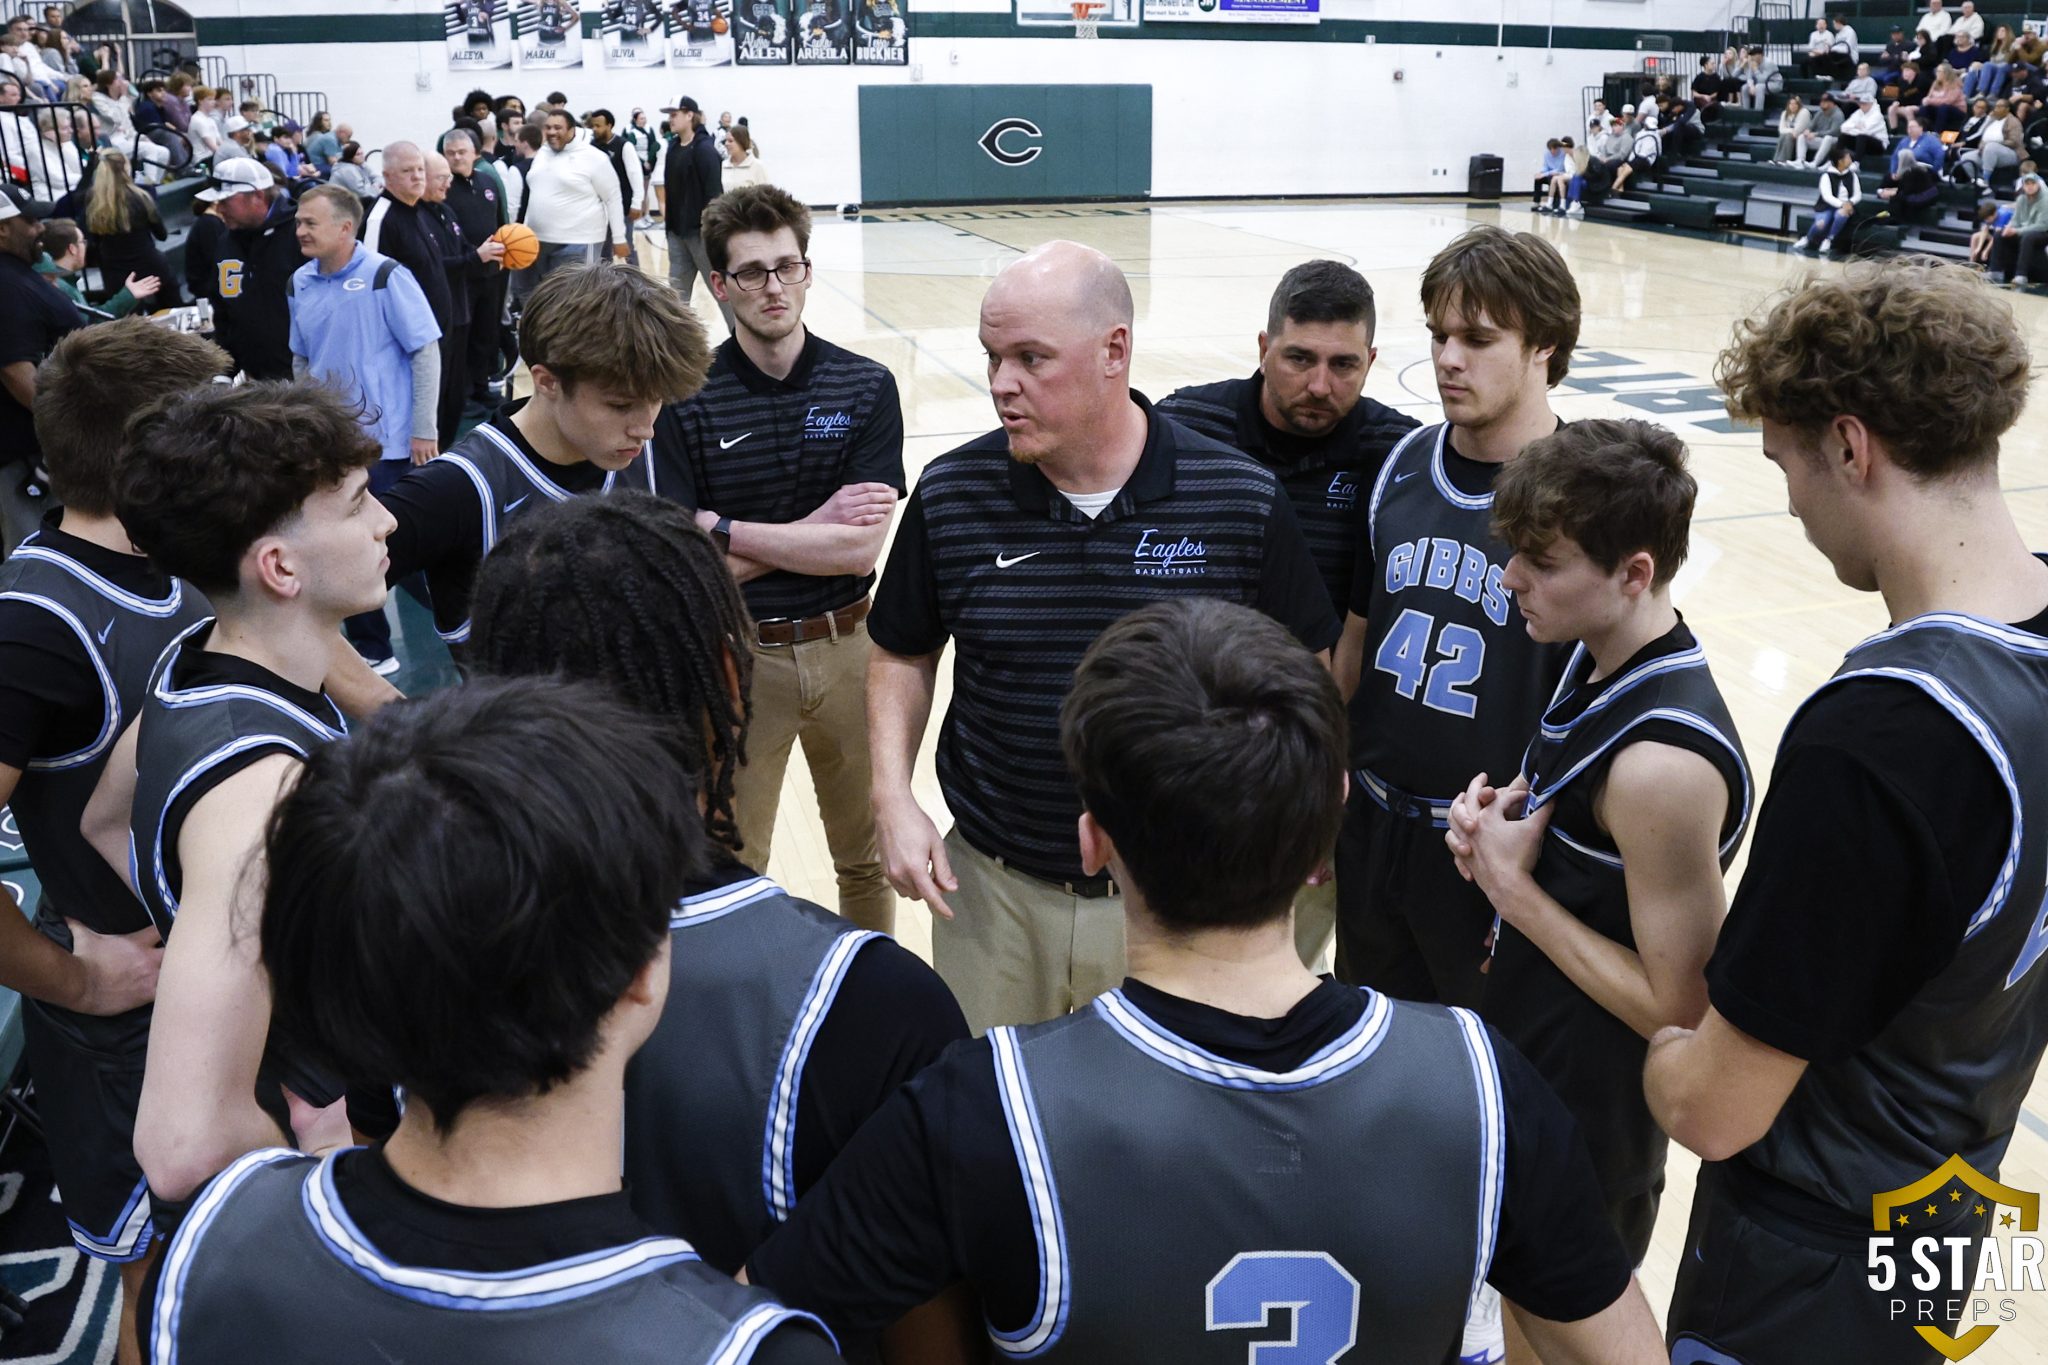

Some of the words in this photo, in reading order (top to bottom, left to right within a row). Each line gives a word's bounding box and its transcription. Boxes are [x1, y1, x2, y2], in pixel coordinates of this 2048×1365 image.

[740, 47, 787, 60] ALLEN
[857, 47, 904, 61] BUCKNER
[977, 118, 1042, 166] C
[217, 259, 244, 298] G
[342, 277, 366, 291] G
[805, 406, 850, 433] Eagles
[1135, 529, 1206, 567] Eagles
[1135, 567, 1205, 575] BASKETBALL
[1386, 537, 1512, 626] GIBBS
[1375, 608, 1486, 719] 42
